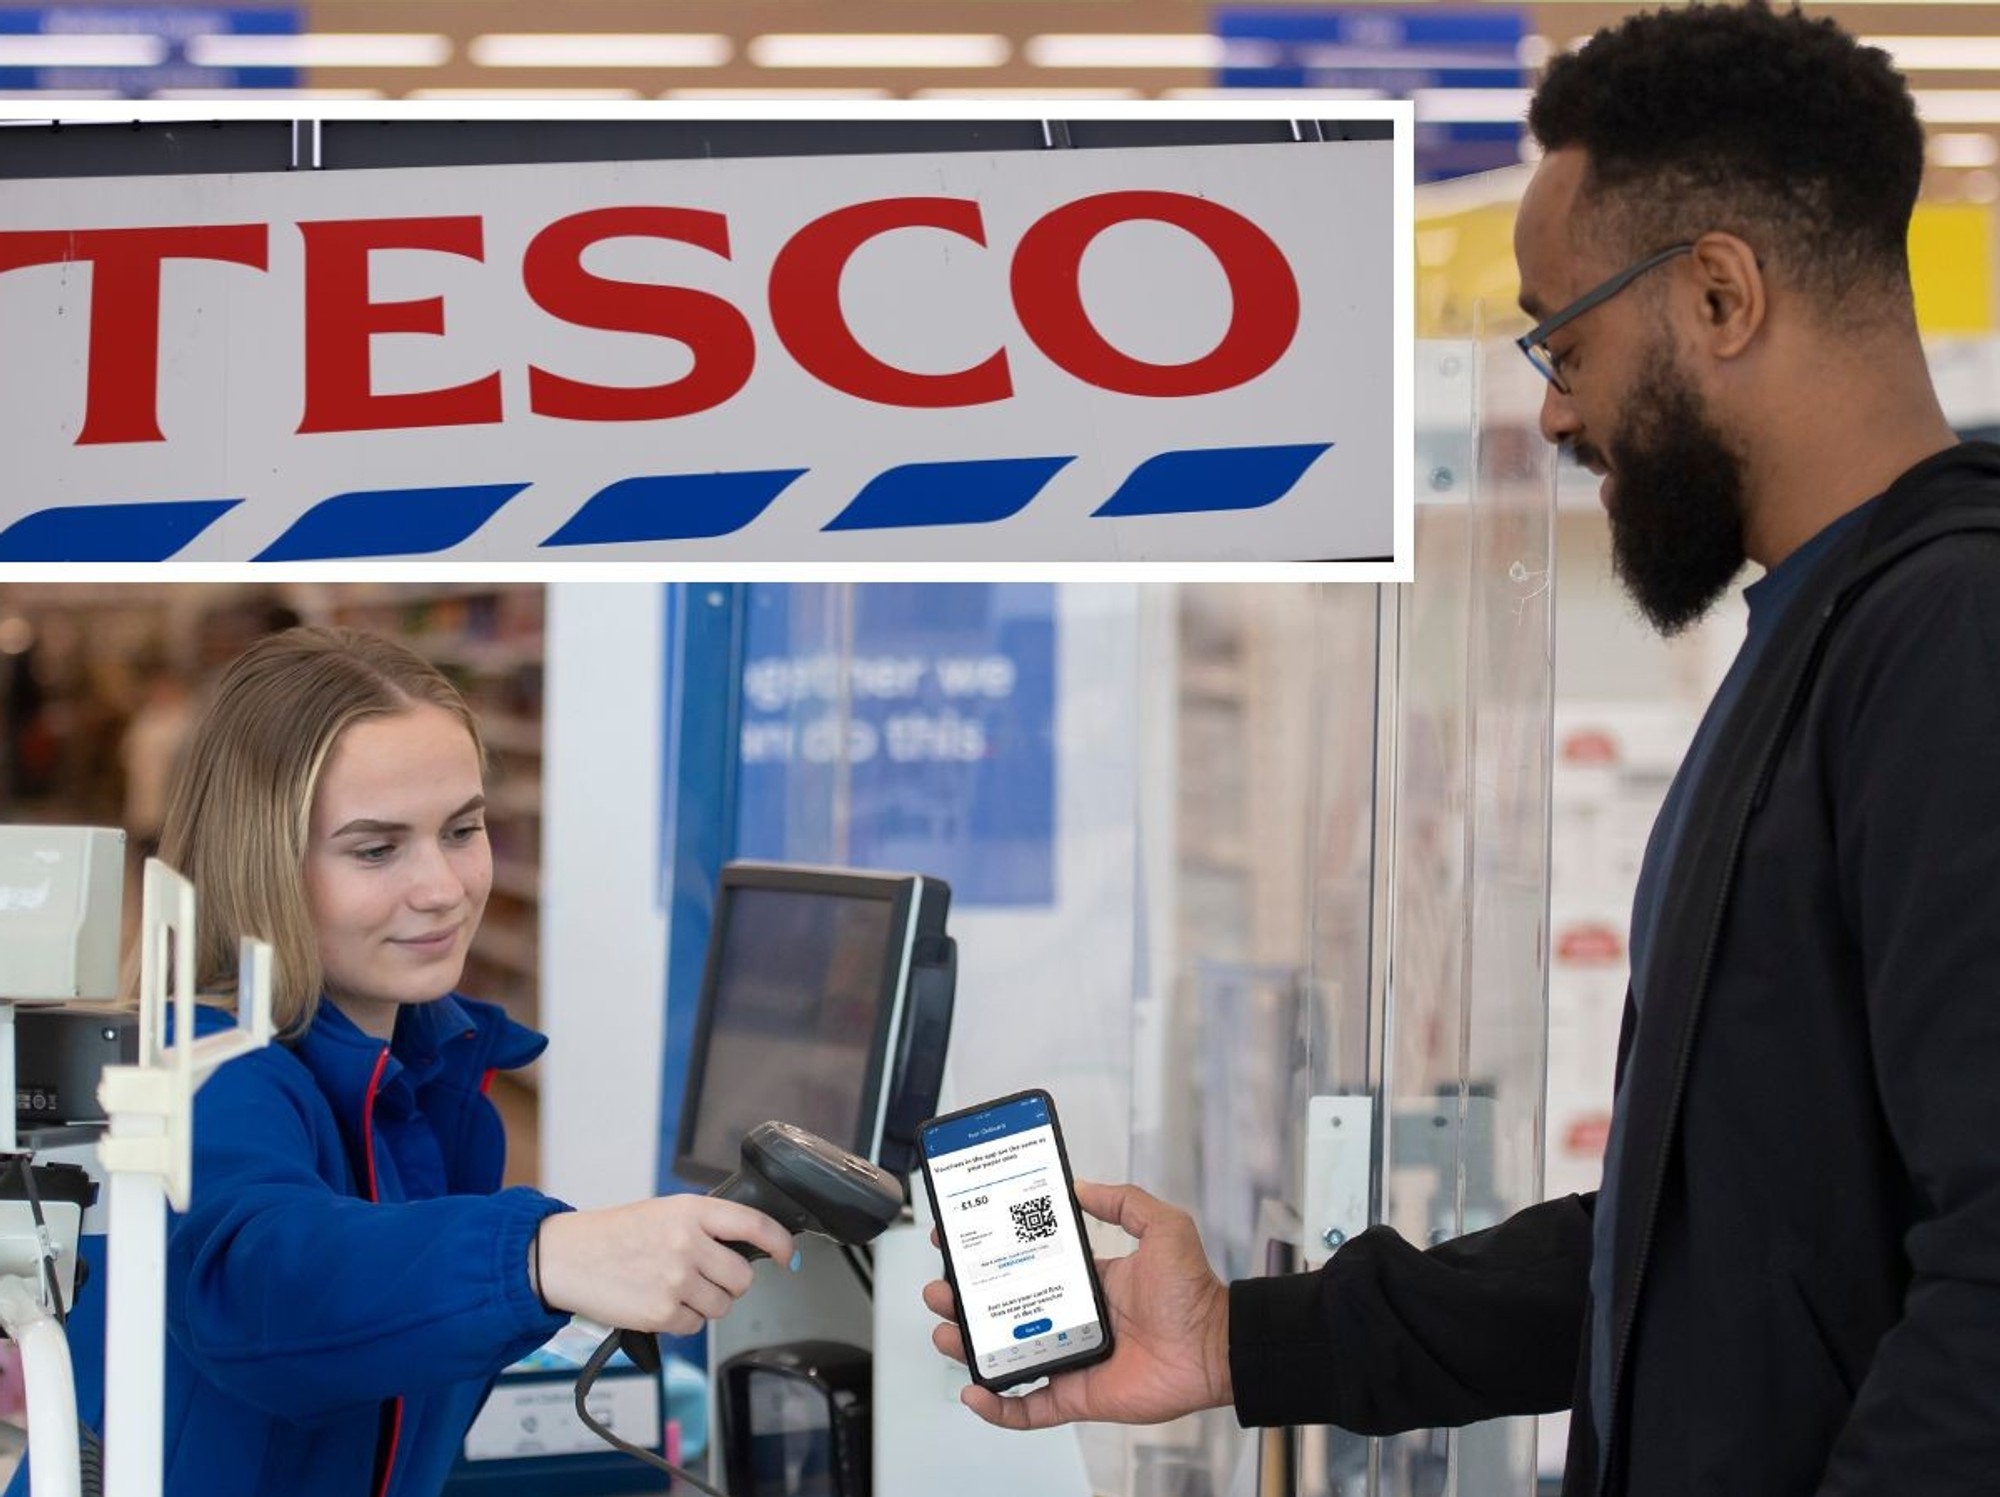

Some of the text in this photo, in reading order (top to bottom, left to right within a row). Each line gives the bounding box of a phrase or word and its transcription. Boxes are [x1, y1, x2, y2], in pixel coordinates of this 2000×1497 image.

[0, 190, 1300, 446] TESCO
[936, 655, 1015, 698] we
[802, 712, 879, 763] do
[960, 1195, 988, 1210] £1.50
